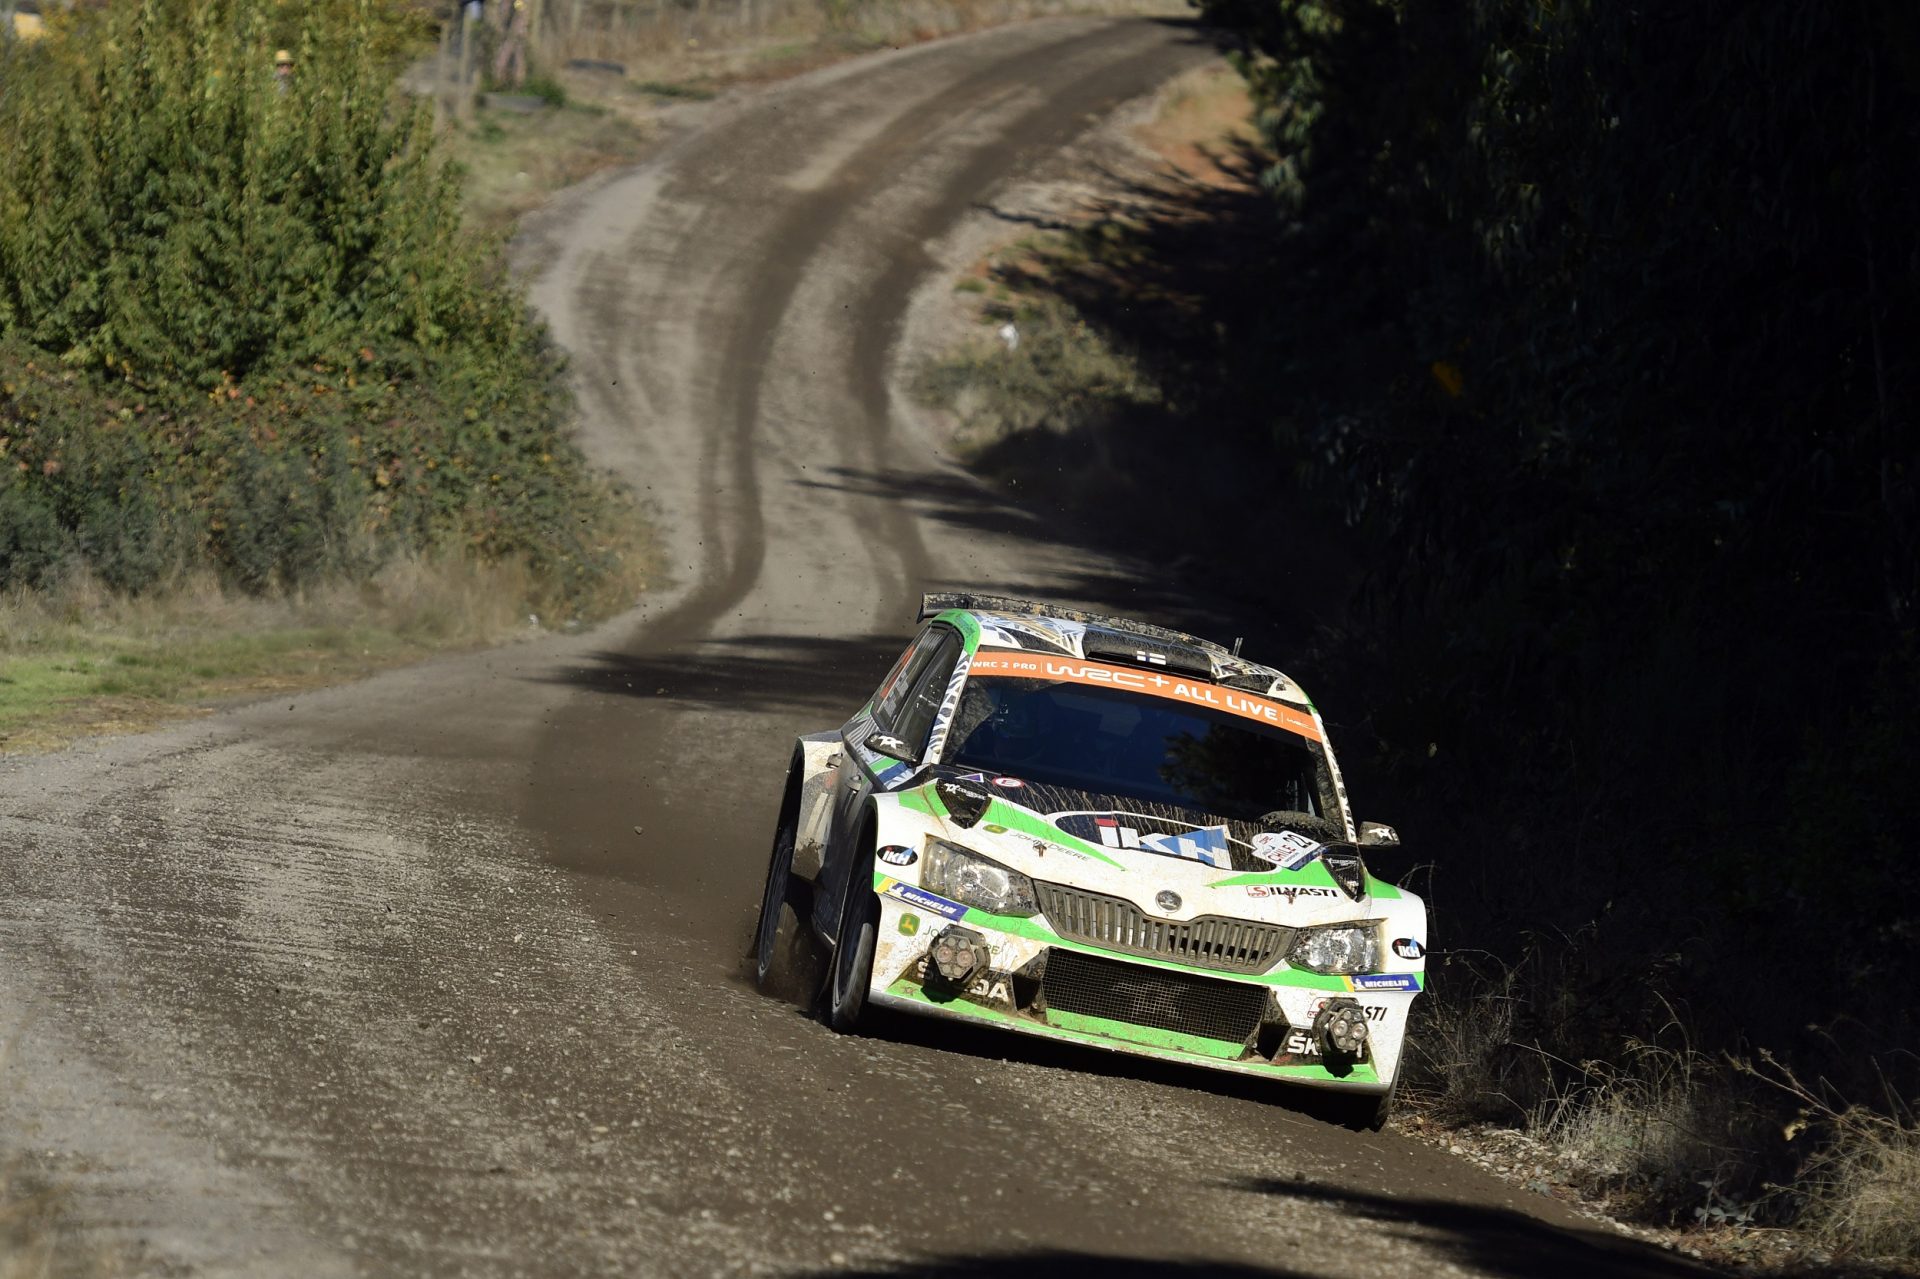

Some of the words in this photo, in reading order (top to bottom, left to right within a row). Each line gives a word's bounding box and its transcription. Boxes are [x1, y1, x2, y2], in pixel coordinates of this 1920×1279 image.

[972, 661, 998, 669] WRC
[1002, 661, 1009, 669] 2
[1012, 662, 1037, 671] PRO
[1174, 683, 1219, 705] ALL
[1226, 695, 1278, 721] LIVE
[1046, 842, 1091, 862] DEERE
[1267, 844, 1297, 862] CHILE
[903, 892, 956, 913] MICHELIN
[1364, 979, 1410, 987] MICHELIN
